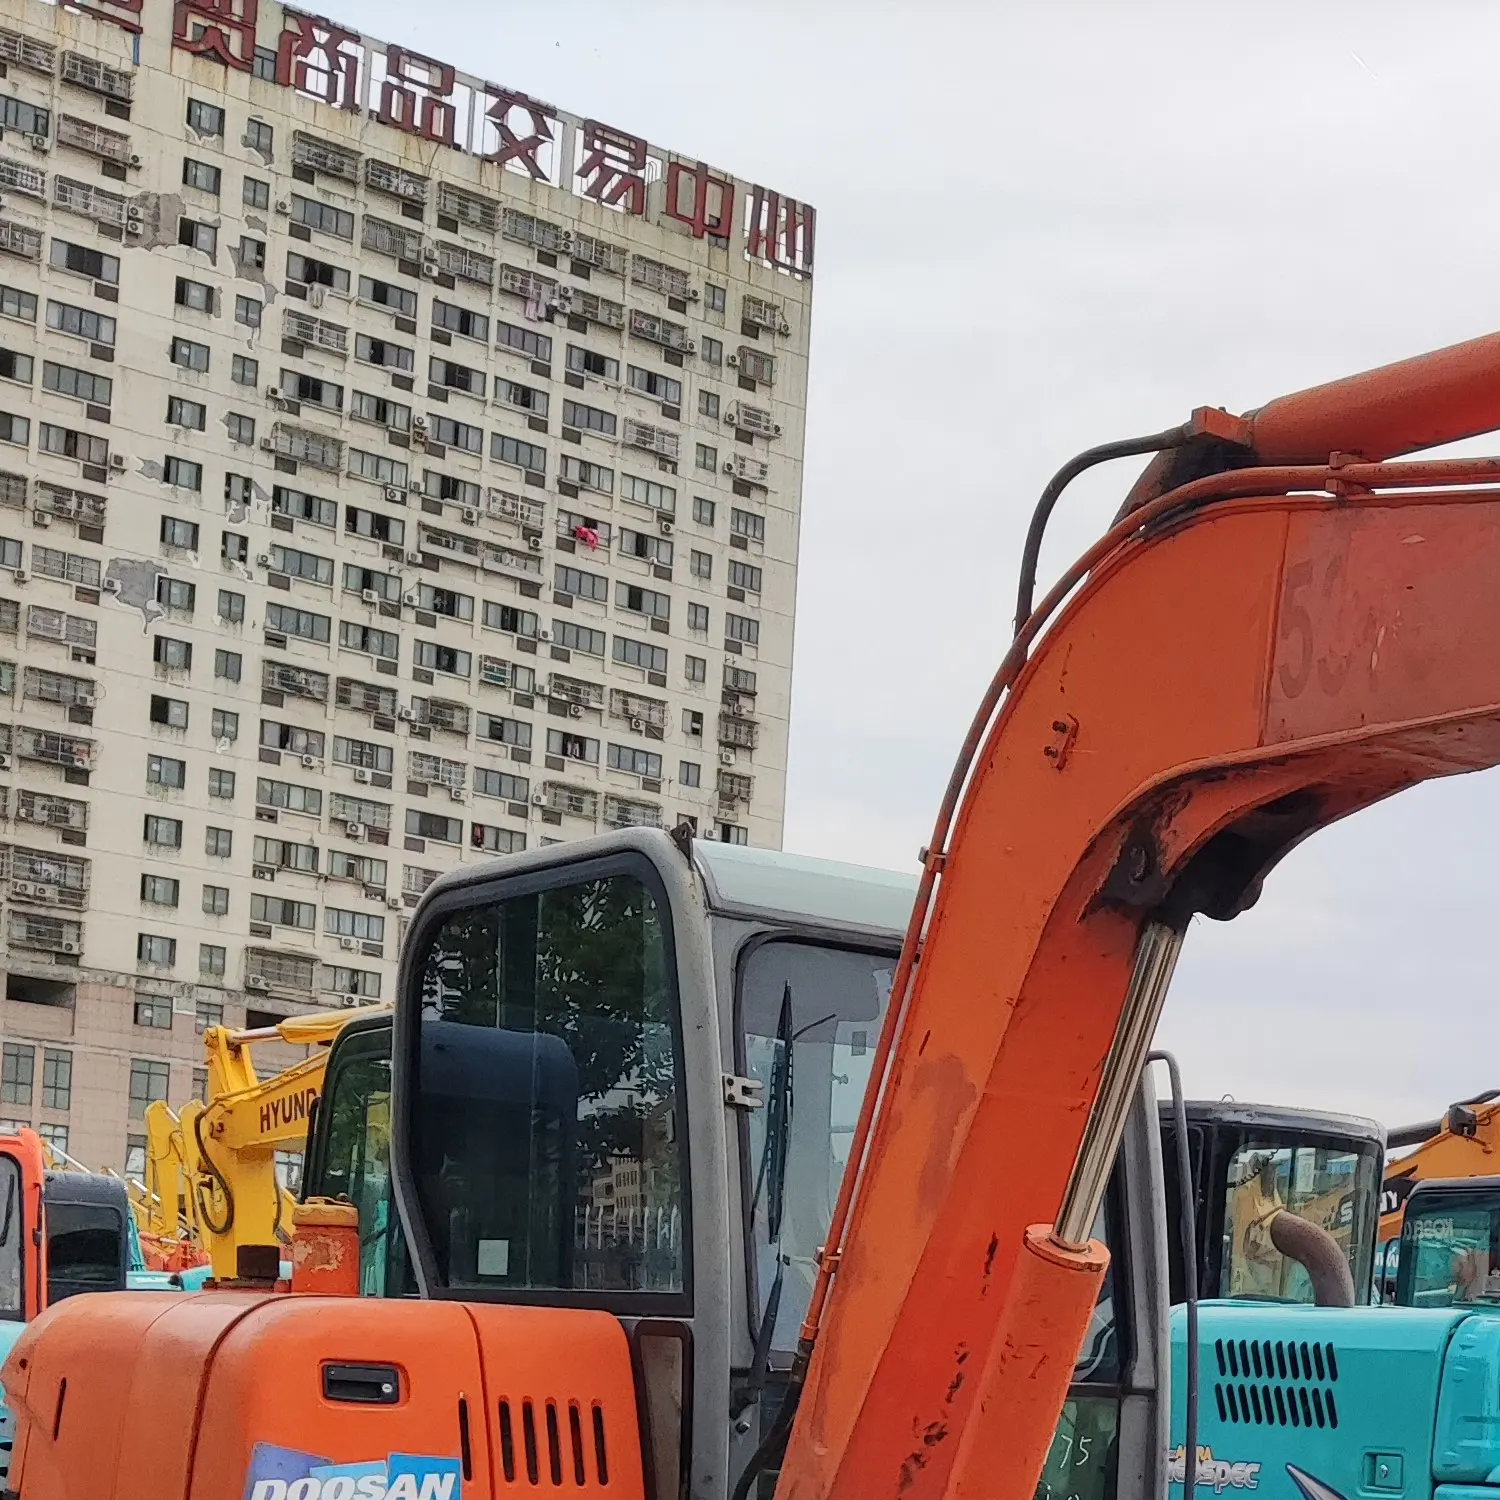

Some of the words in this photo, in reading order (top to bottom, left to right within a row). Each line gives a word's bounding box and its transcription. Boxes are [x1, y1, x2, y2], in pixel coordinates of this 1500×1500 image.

[60, 0, 815, 279] 贸商品交易中心
